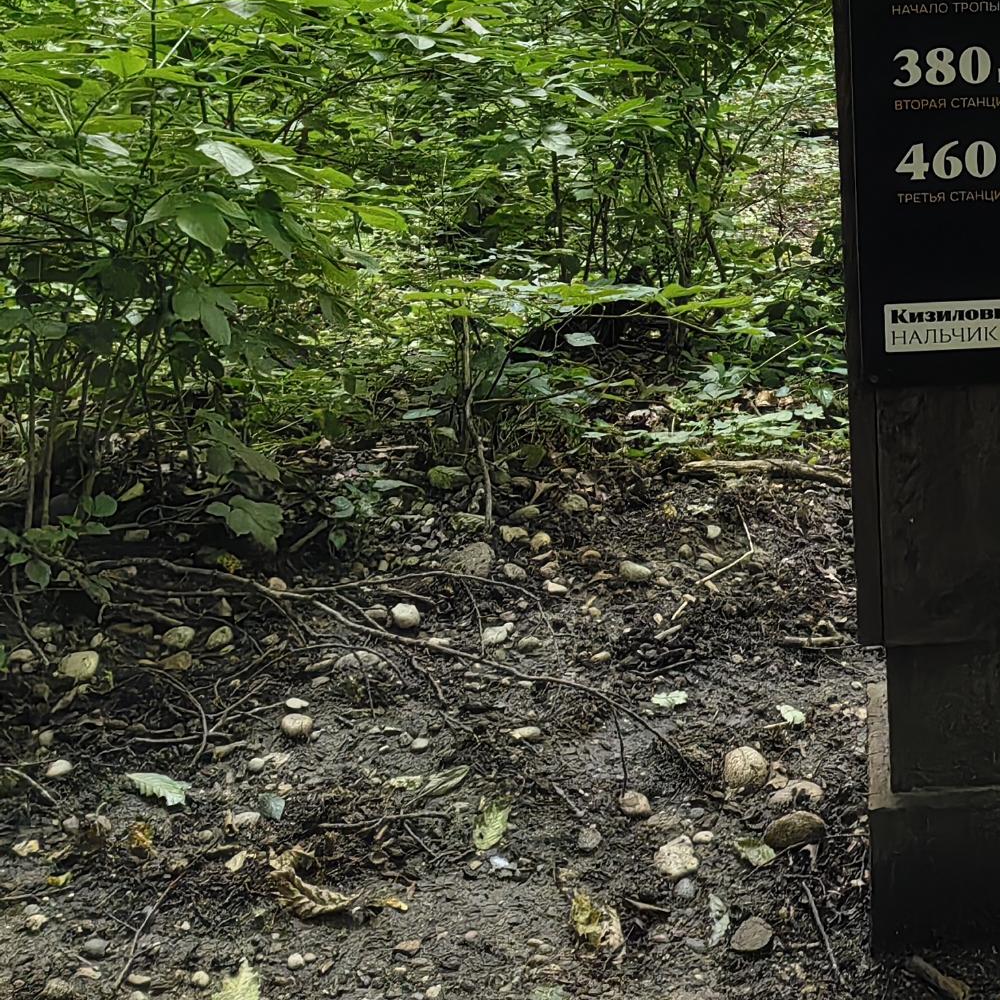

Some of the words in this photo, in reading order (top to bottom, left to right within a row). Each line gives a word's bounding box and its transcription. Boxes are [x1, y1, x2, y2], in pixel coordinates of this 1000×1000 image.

[892, 3, 949, 15] НАЧАЛО
[952, 1, 1000, 13] ТРОПЫ
[893, 46, 991, 86] 380
[894, 98, 946, 110] ВТОРАЯ
[895, 140, 997, 180] 460
[897, 192, 946, 204] ТРЕТЬЯ
[892, 326, 998, 345] НАЛЬЧИК
